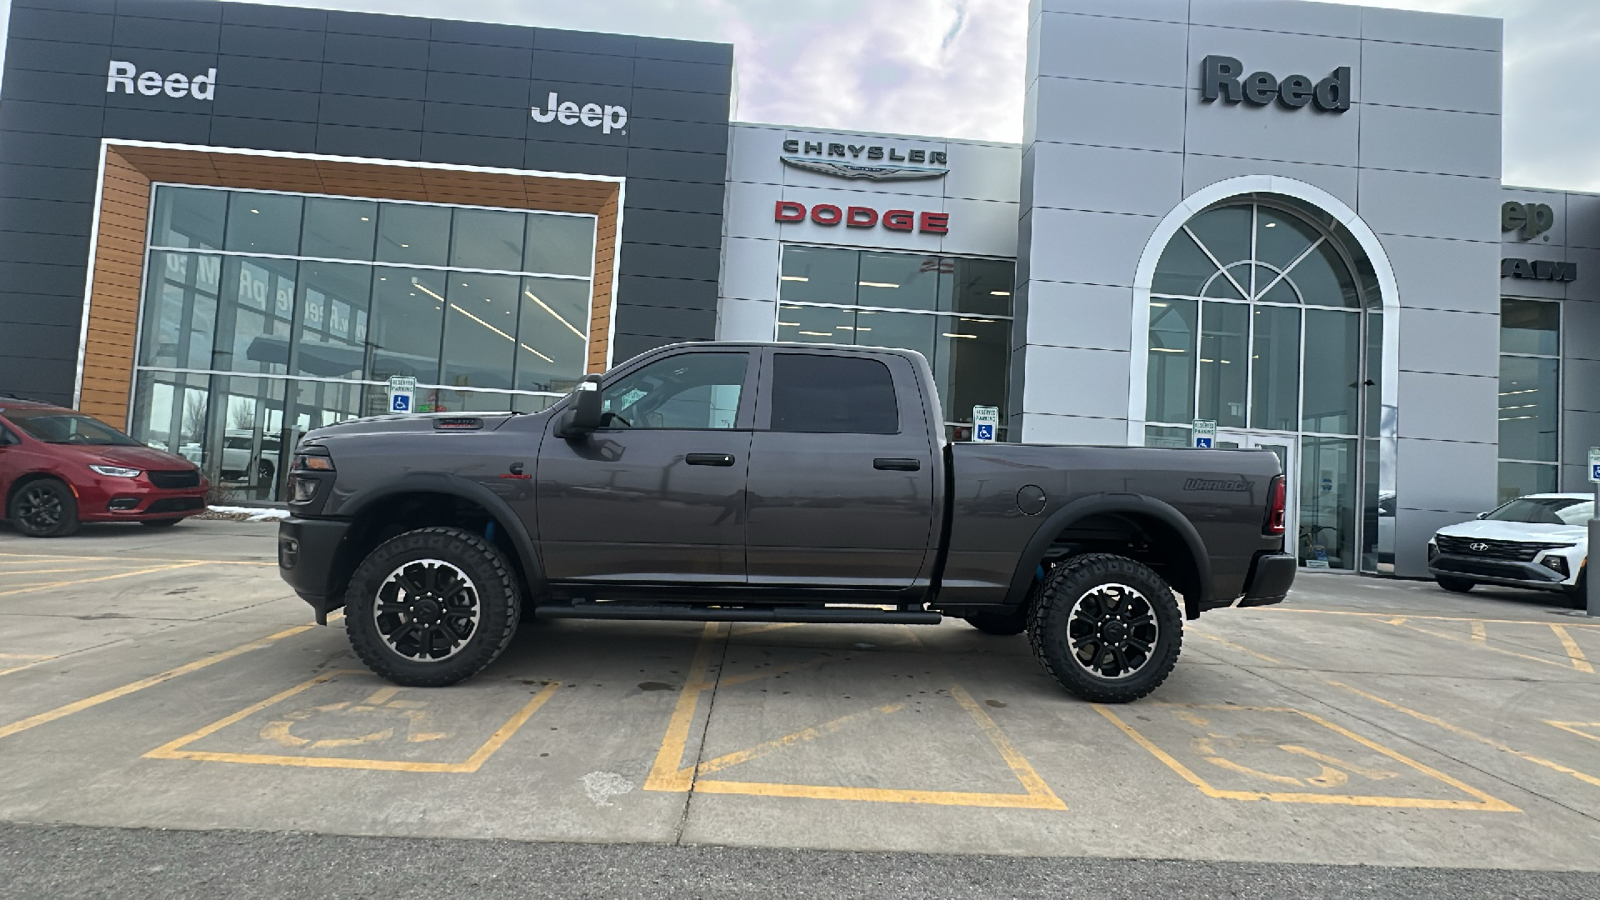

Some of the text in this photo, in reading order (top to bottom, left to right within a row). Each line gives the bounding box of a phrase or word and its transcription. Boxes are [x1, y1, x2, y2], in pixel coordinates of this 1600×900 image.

[106, 60, 217, 100] Reed
[1201, 55, 1351, 113] Reed
[531, 92, 628, 135] Jeep
[783, 139, 948, 164] CHRYSLER
[774, 200, 949, 235] DODGE
[1501, 201, 1553, 242] ep
[1501, 257, 1577, 283] AM
